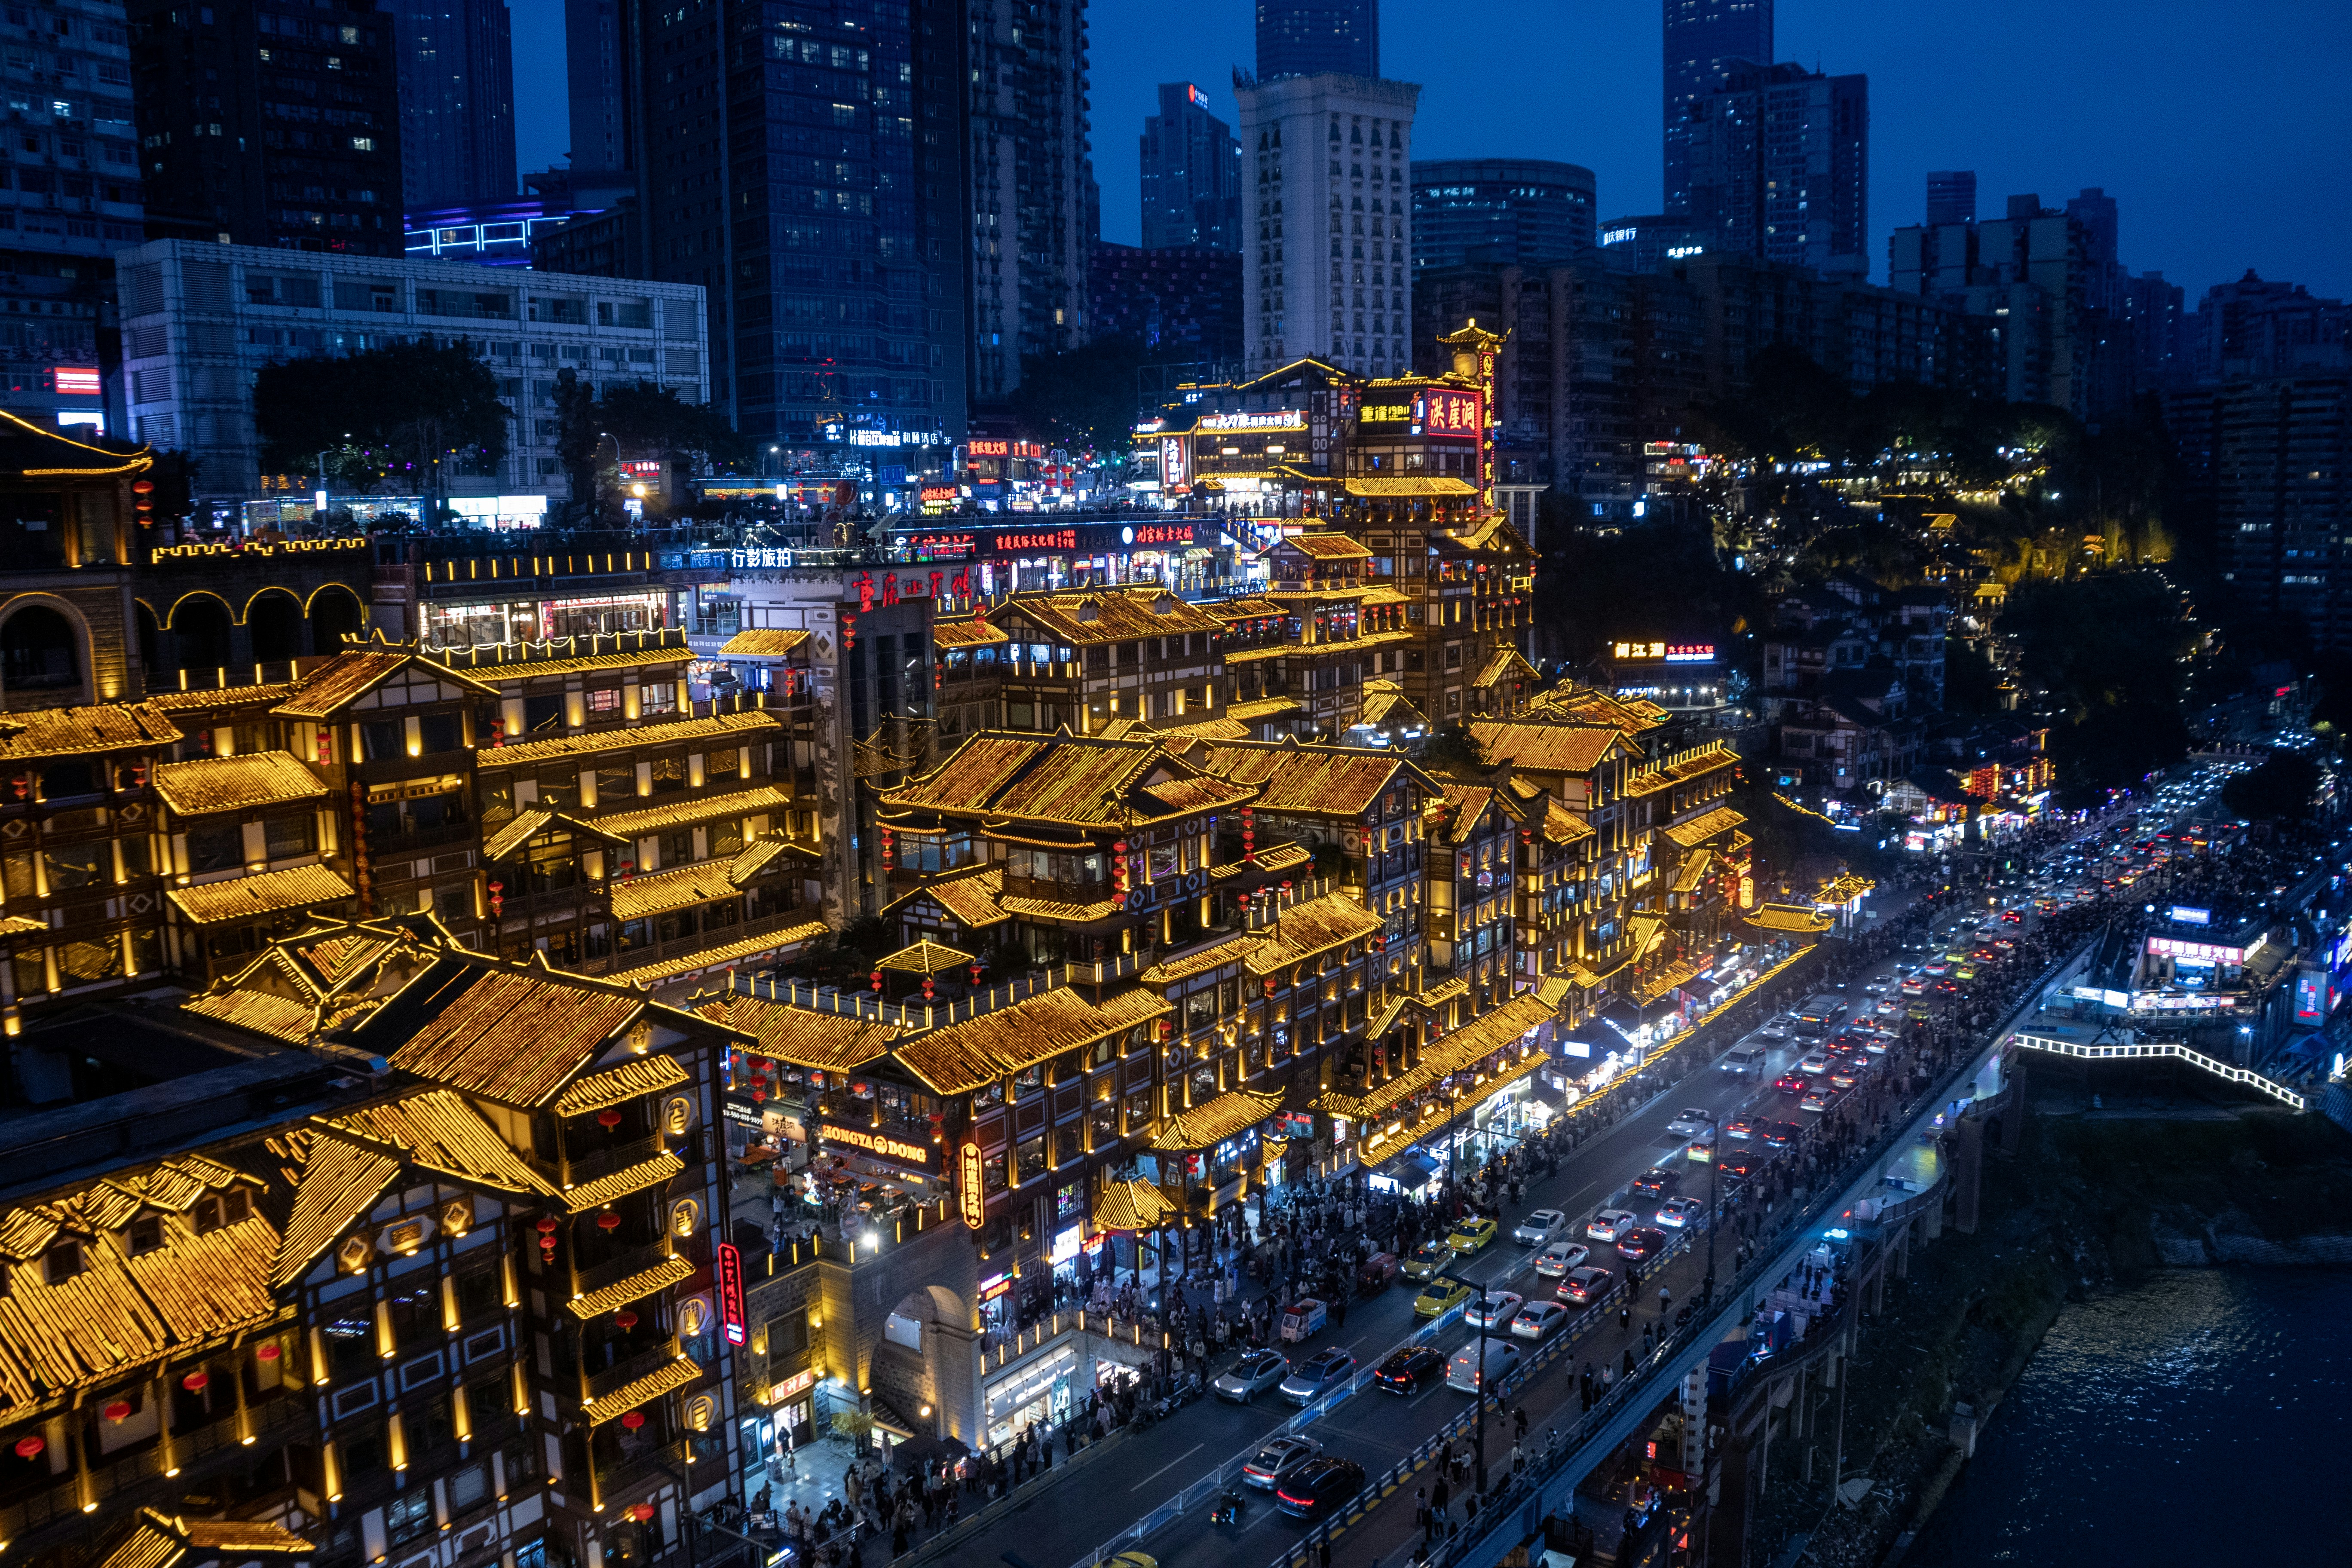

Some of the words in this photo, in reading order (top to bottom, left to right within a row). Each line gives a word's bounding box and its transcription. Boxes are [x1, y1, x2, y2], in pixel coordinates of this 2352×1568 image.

[1604, 228, 1637, 246] 重庆银行
[1430, 395, 1475, 431] 洪崖洞
[902, 432, 938, 444] 和颐酒店
[1136, 525, 1194, 543] 九宫格老火锅
[731, 548, 791, 568] 行影旅拍
[822, 1124, 874, 1150] HONGYA
[888, 1140, 927, 1163] DONG
